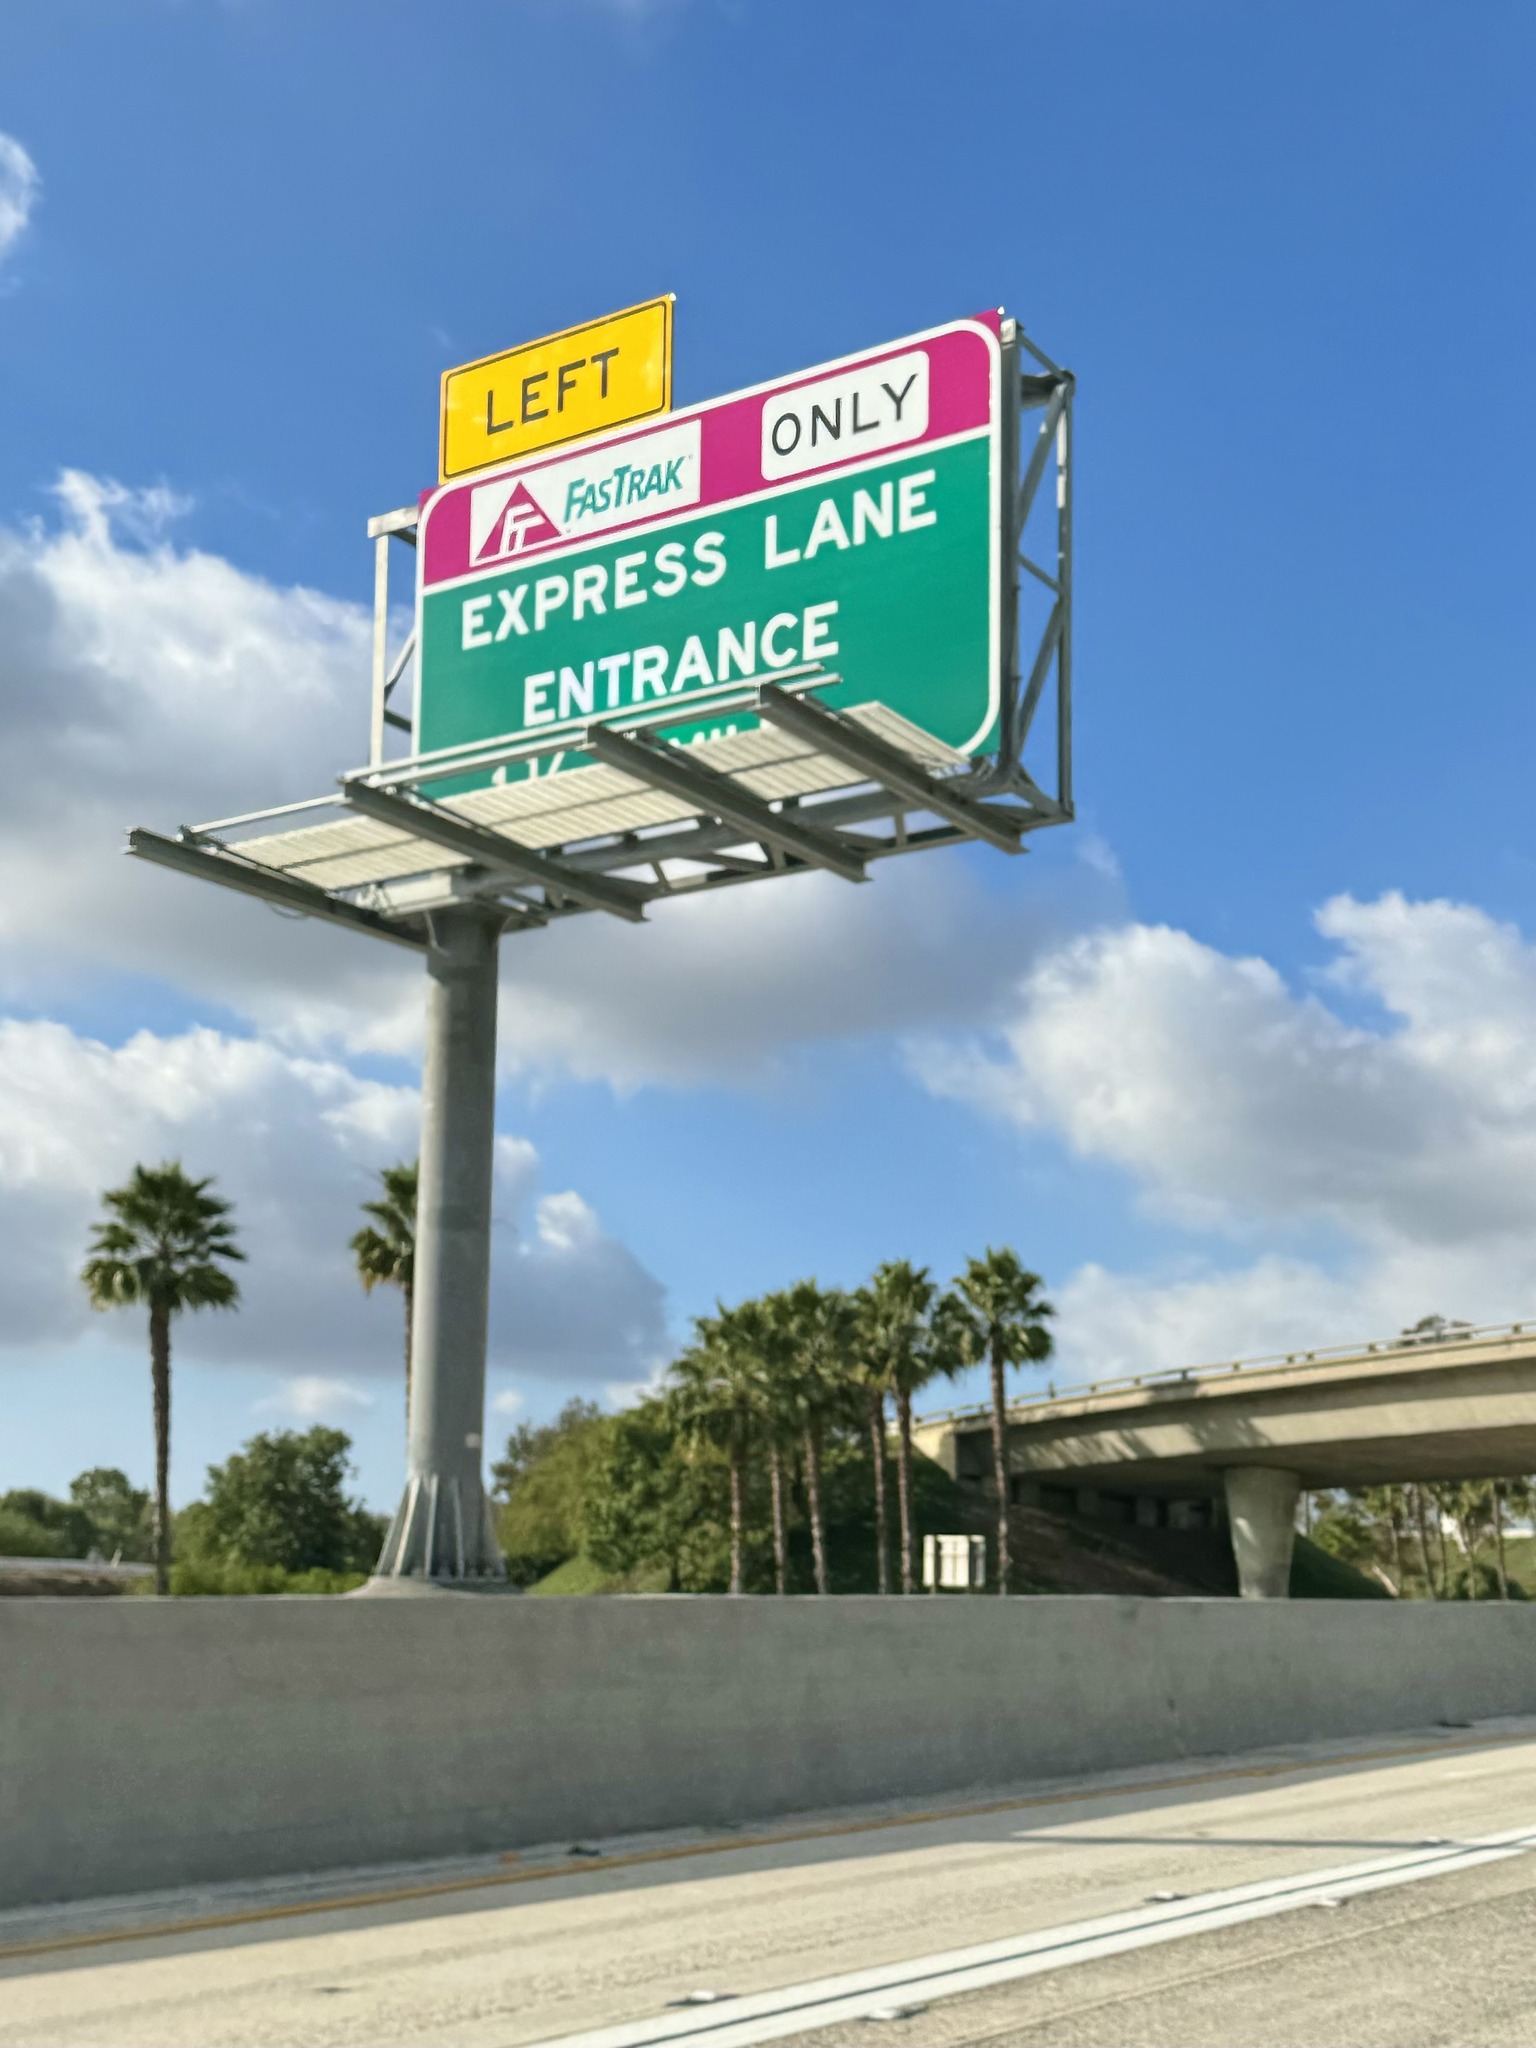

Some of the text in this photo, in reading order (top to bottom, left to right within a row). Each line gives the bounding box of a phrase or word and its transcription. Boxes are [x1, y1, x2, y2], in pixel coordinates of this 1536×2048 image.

[486, 348, 620, 435] LEFT
[771, 374, 918, 456] ONLY
[461, 469, 937, 651] EXPRESS LANE
[523, 600, 840, 729] ENTRANCE
